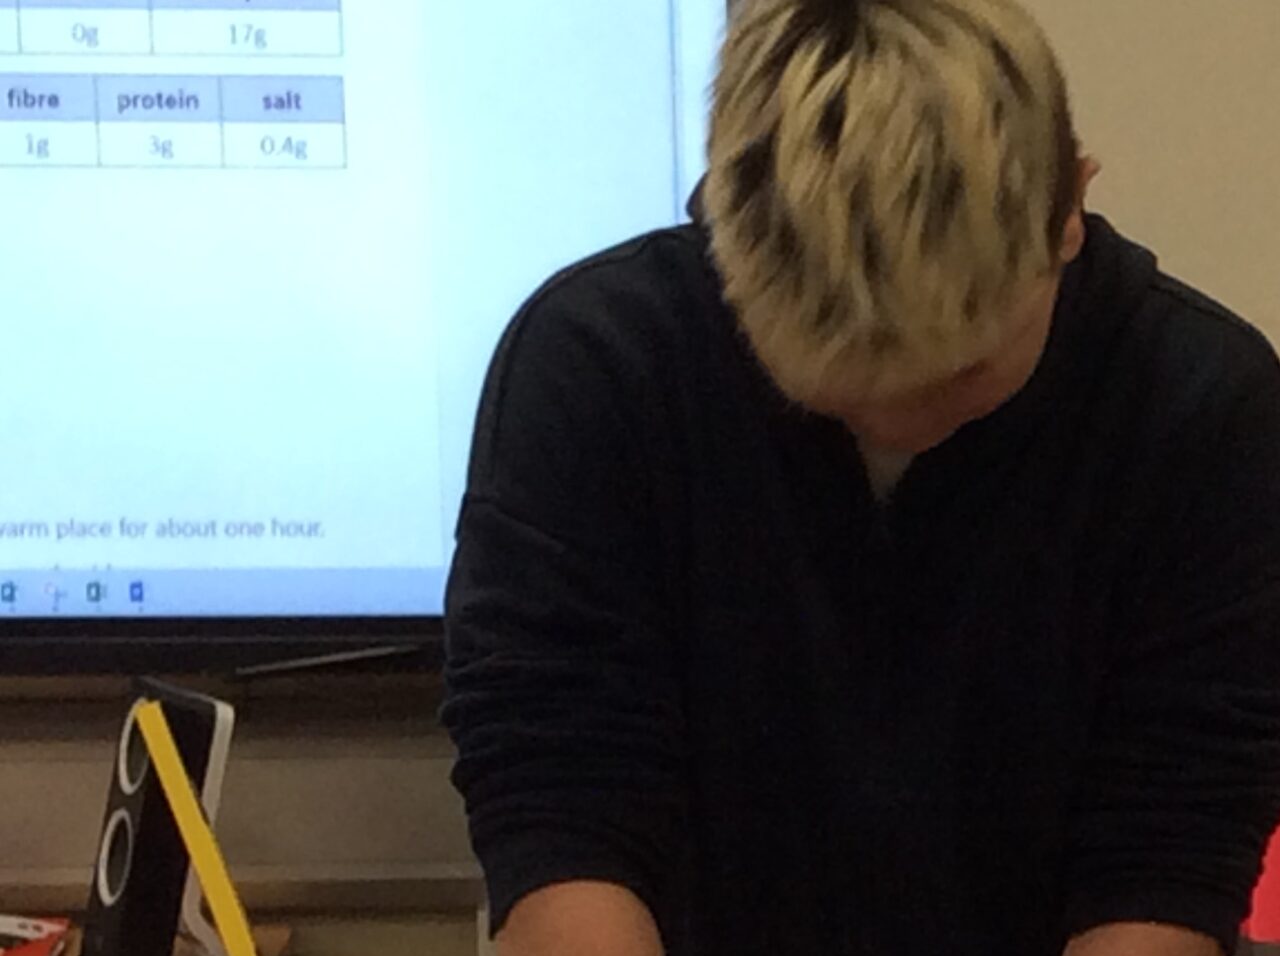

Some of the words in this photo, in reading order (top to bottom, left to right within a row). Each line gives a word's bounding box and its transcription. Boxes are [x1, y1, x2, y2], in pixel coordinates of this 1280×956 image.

[71, 23, 99, 48] 0g
[229, 24, 267, 49] 17g
[7, 88, 60, 109] fibre
[117, 89, 200, 114] protein
[262, 90, 302, 110] salt
[25, 133, 50, 158] 1g
[149, 136, 174, 159] 3g
[56, 518, 112, 543] place
[119, 517, 147, 538] for
[155, 518, 217, 539] about
[224, 521, 265, 539] one
[271, 518, 326, 539] hour.
